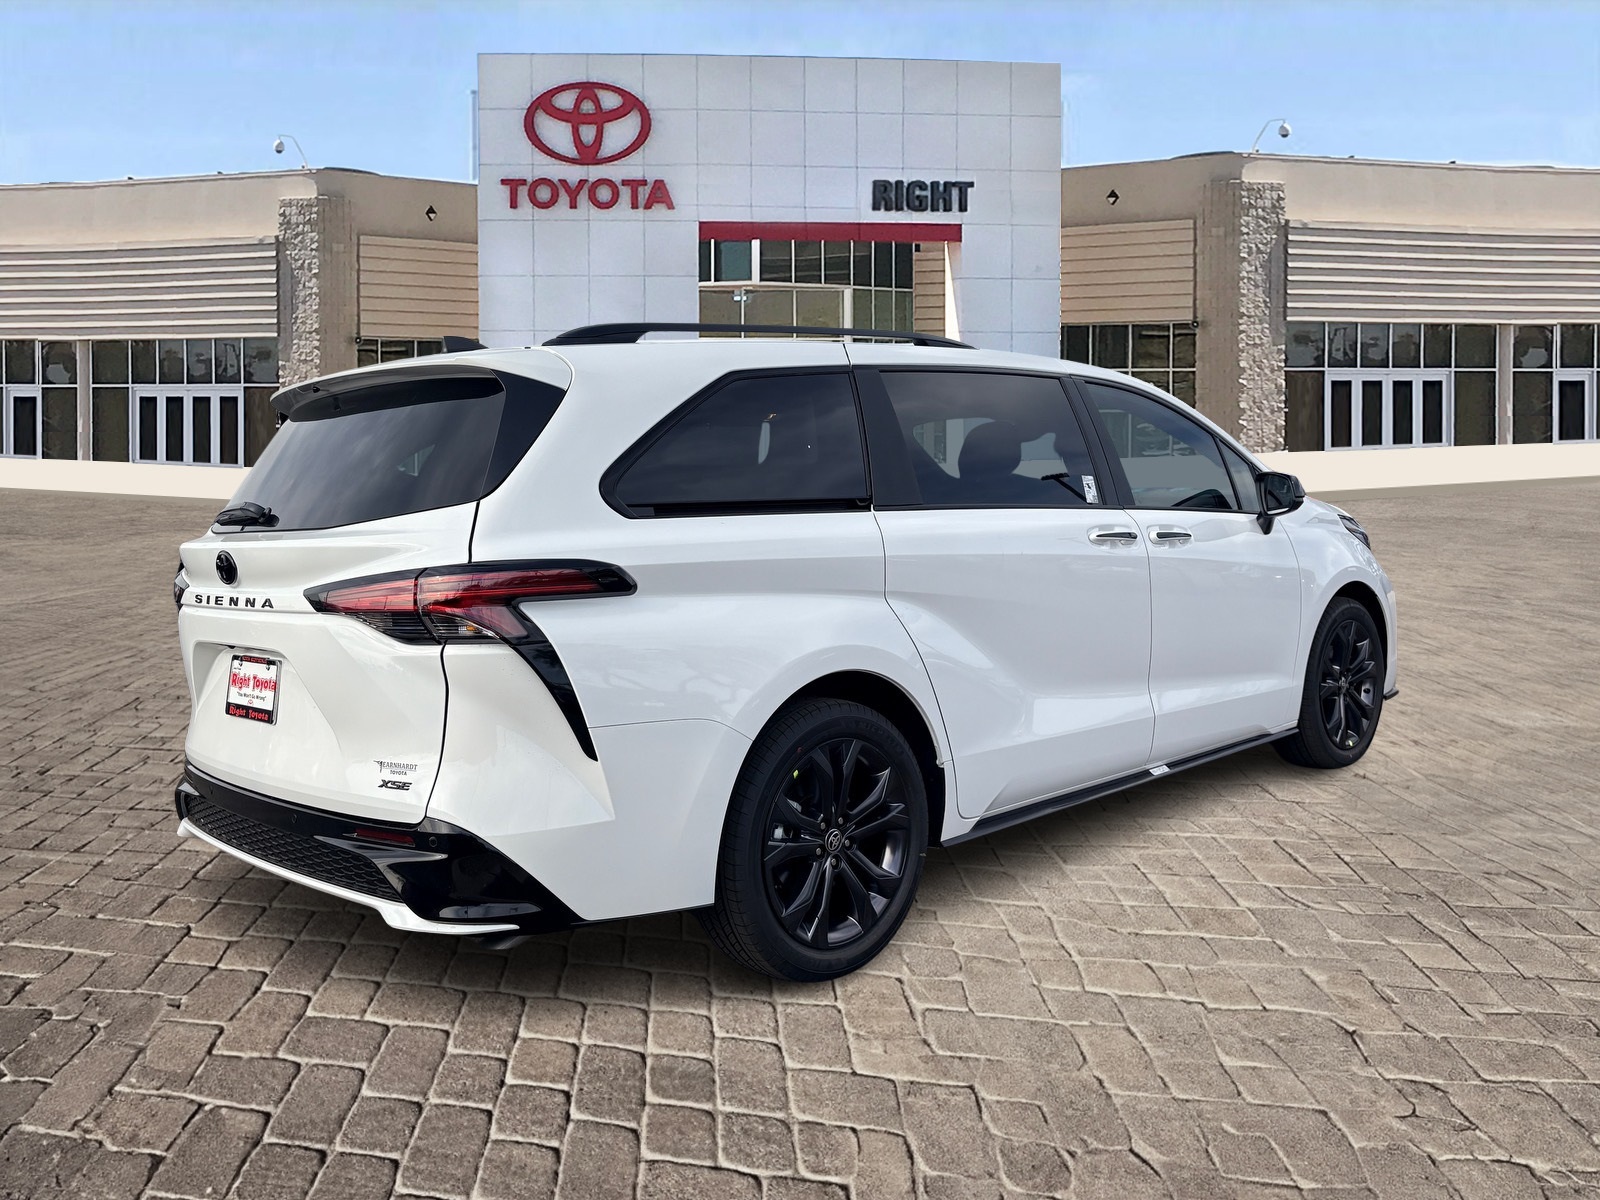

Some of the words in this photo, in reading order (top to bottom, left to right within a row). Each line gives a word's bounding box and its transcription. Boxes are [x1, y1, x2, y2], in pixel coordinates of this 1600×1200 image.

[500, 178, 675, 210] TOYOTA
[871, 179, 975, 213] RIGHT
[194, 594, 274, 608] SIENNA
[231, 672, 251, 691] Right
[252, 674, 277, 693] Toyota
[229, 704, 246, 716] Right
[249, 709, 268, 720] Toyota
[382, 761, 418, 771] EARNHARDT
[378, 779, 413, 791] XSE
